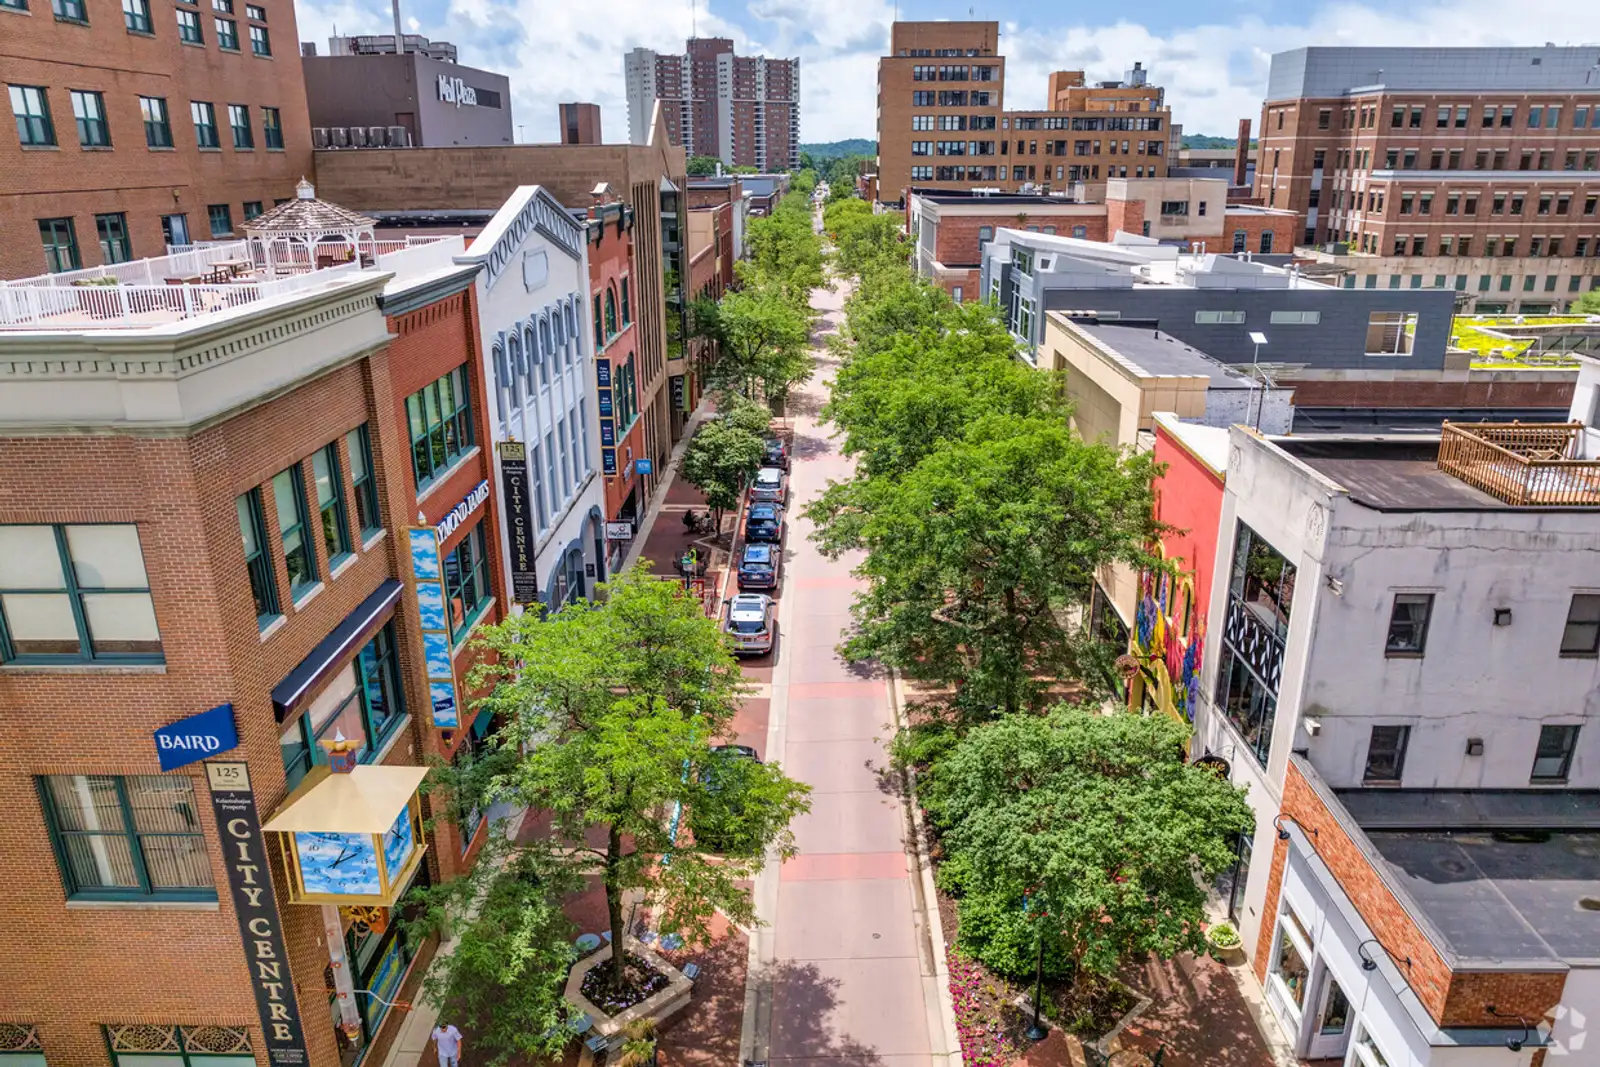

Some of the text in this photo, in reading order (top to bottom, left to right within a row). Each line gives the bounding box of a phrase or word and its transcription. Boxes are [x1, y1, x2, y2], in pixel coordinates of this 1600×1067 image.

[438, 74, 477, 108] Mall Plaza
[437, 480, 490, 546] YMOND JAMES
[511, 476, 522, 513] CITY
[515, 517, 528, 571] CENTRE
[158, 735, 220, 752] BAIRD
[216, 767, 239, 778] 125
[227, 818, 264, 907] CITY
[248, 917, 293, 1040] CENTRE
